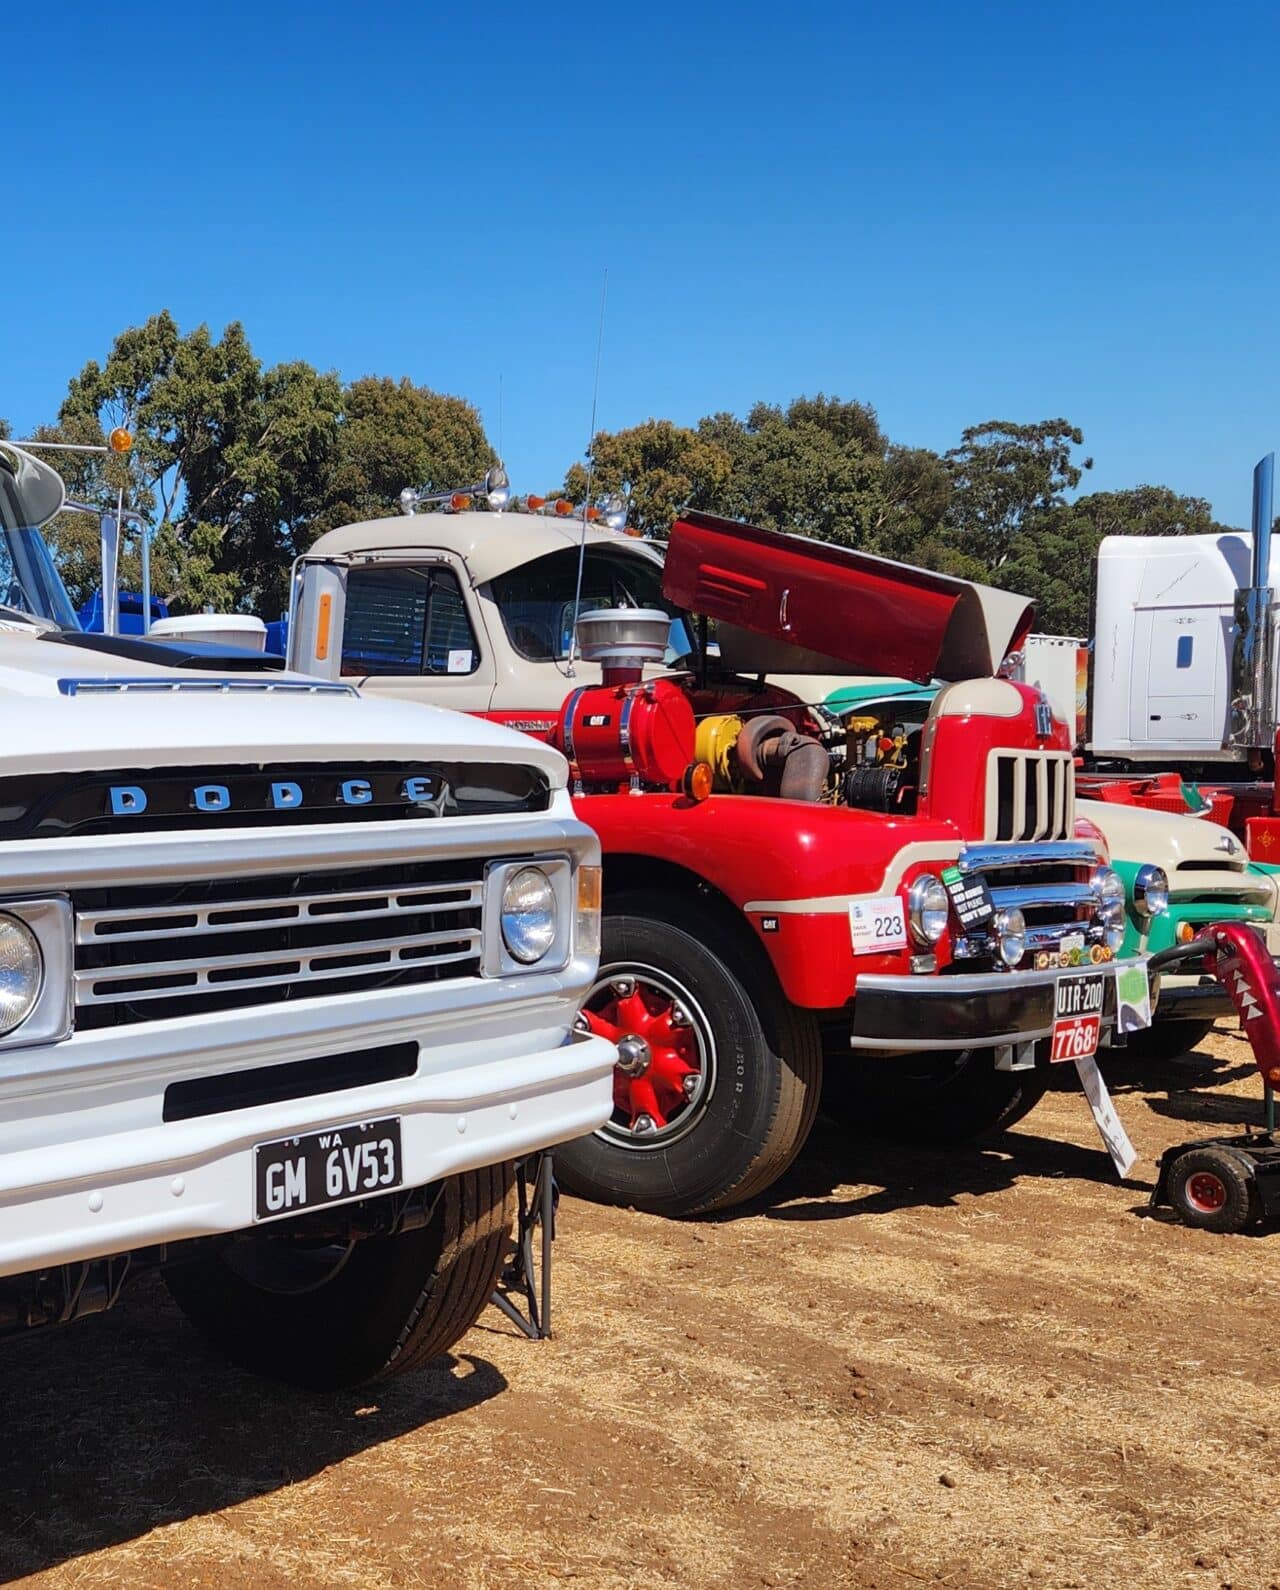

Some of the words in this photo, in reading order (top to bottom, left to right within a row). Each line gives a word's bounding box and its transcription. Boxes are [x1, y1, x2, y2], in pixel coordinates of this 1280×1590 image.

[109, 777, 433, 815] DODGE
[763, 919, 776, 930] CAT
[874, 915, 903, 938] 223
[1056, 1024, 1093, 1060] 7768
[319, 1133, 343, 1149] WA
[265, 1156, 307, 1211] GM
[326, 1138, 395, 1197] 6V53
